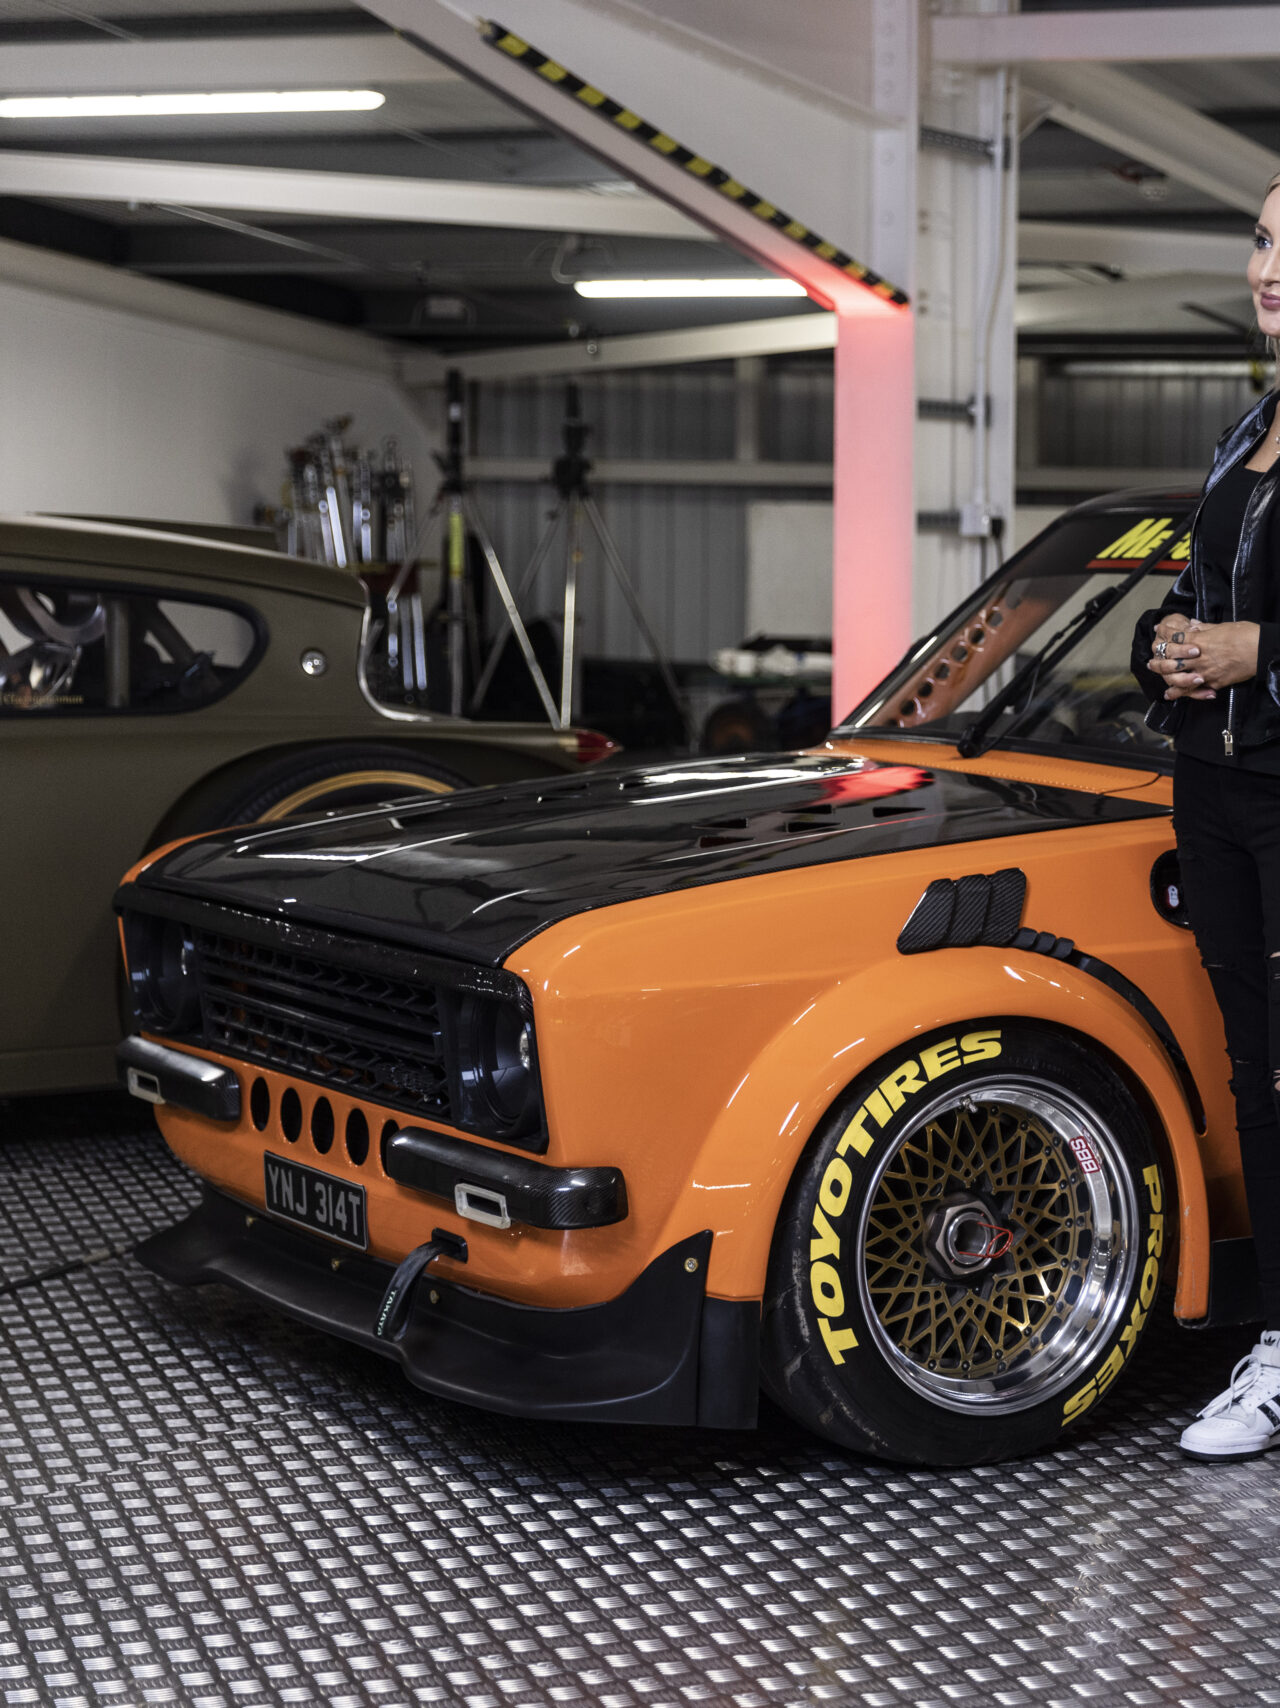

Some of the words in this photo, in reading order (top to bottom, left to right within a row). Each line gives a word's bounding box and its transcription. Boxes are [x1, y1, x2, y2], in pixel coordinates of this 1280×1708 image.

[1070, 1137, 1099, 1174] BBS
[267, 1163, 307, 1216] YNJ
[314, 1181, 361, 1237] 314T
[377, 1289, 398, 1336] TAKATA
[1061, 1163, 1163, 1427] PROXES
